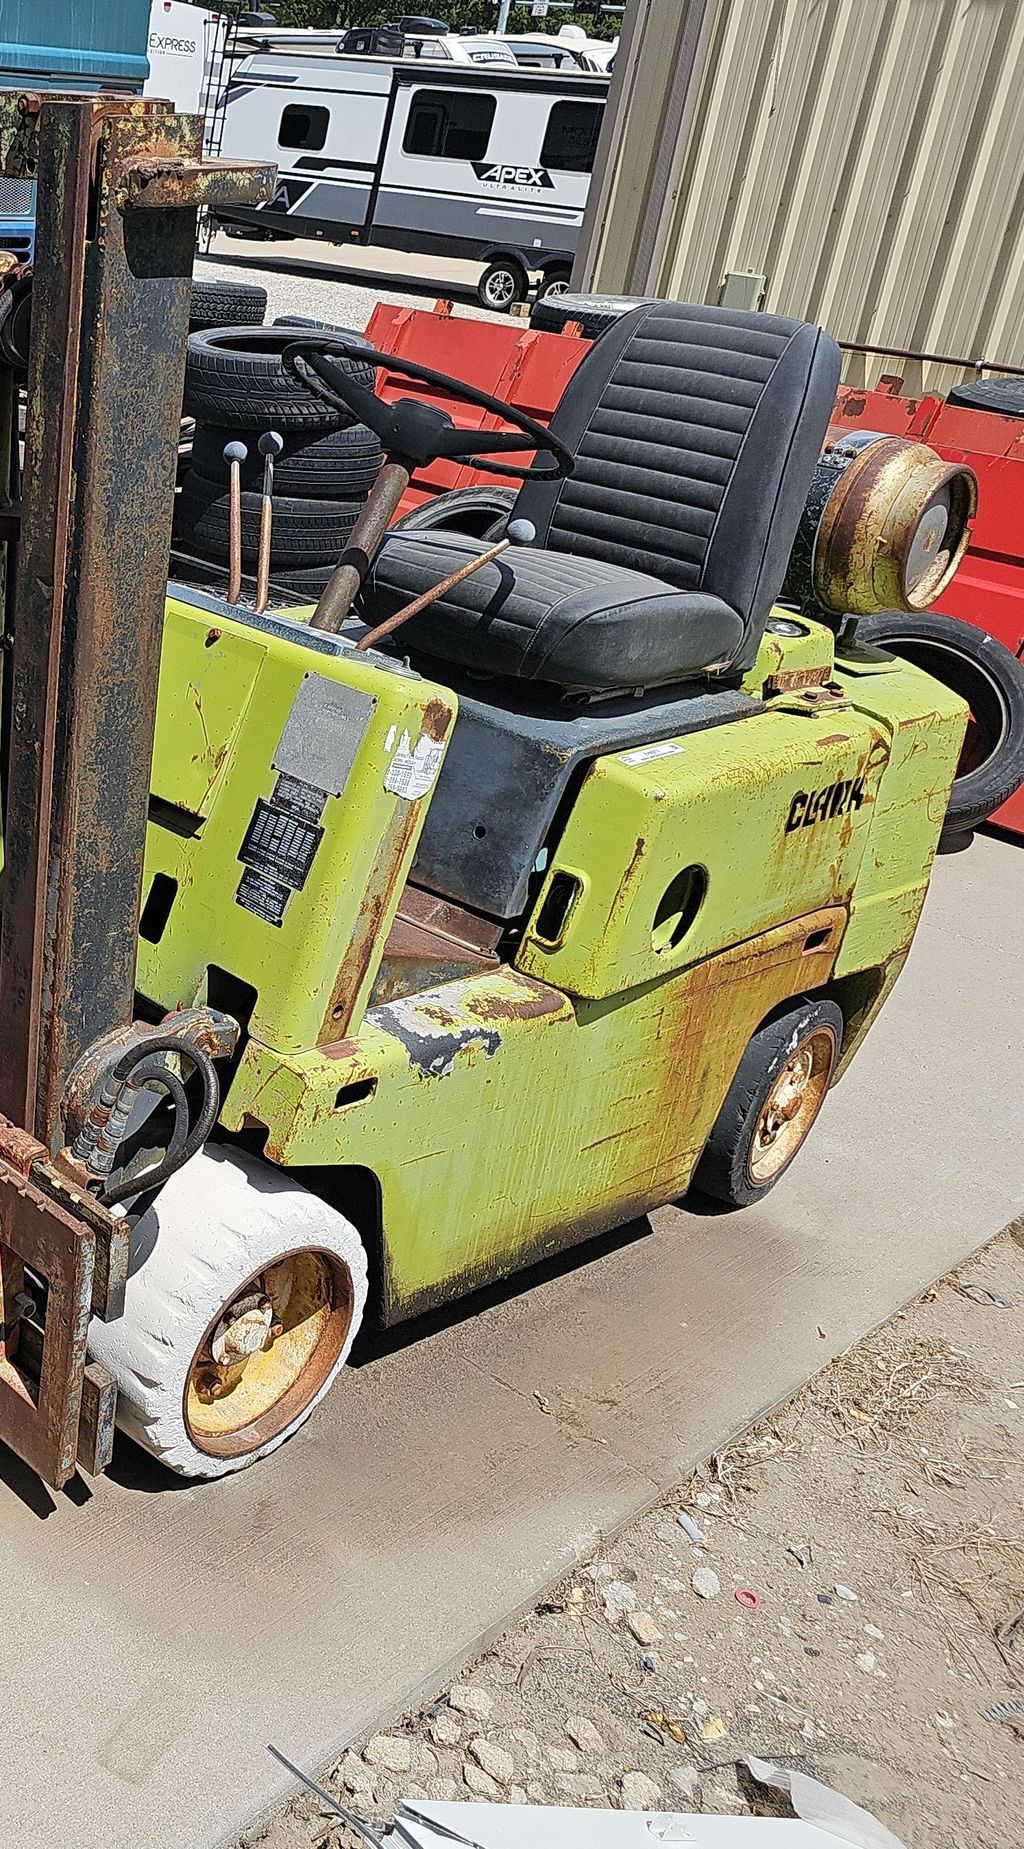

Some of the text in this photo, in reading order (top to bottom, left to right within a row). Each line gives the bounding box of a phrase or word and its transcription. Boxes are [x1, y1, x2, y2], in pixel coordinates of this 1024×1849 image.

[149, 33, 196, 53] EXPRESS
[479, 164, 545, 186] APEX
[482, 182, 543, 194] ULTRALITE
